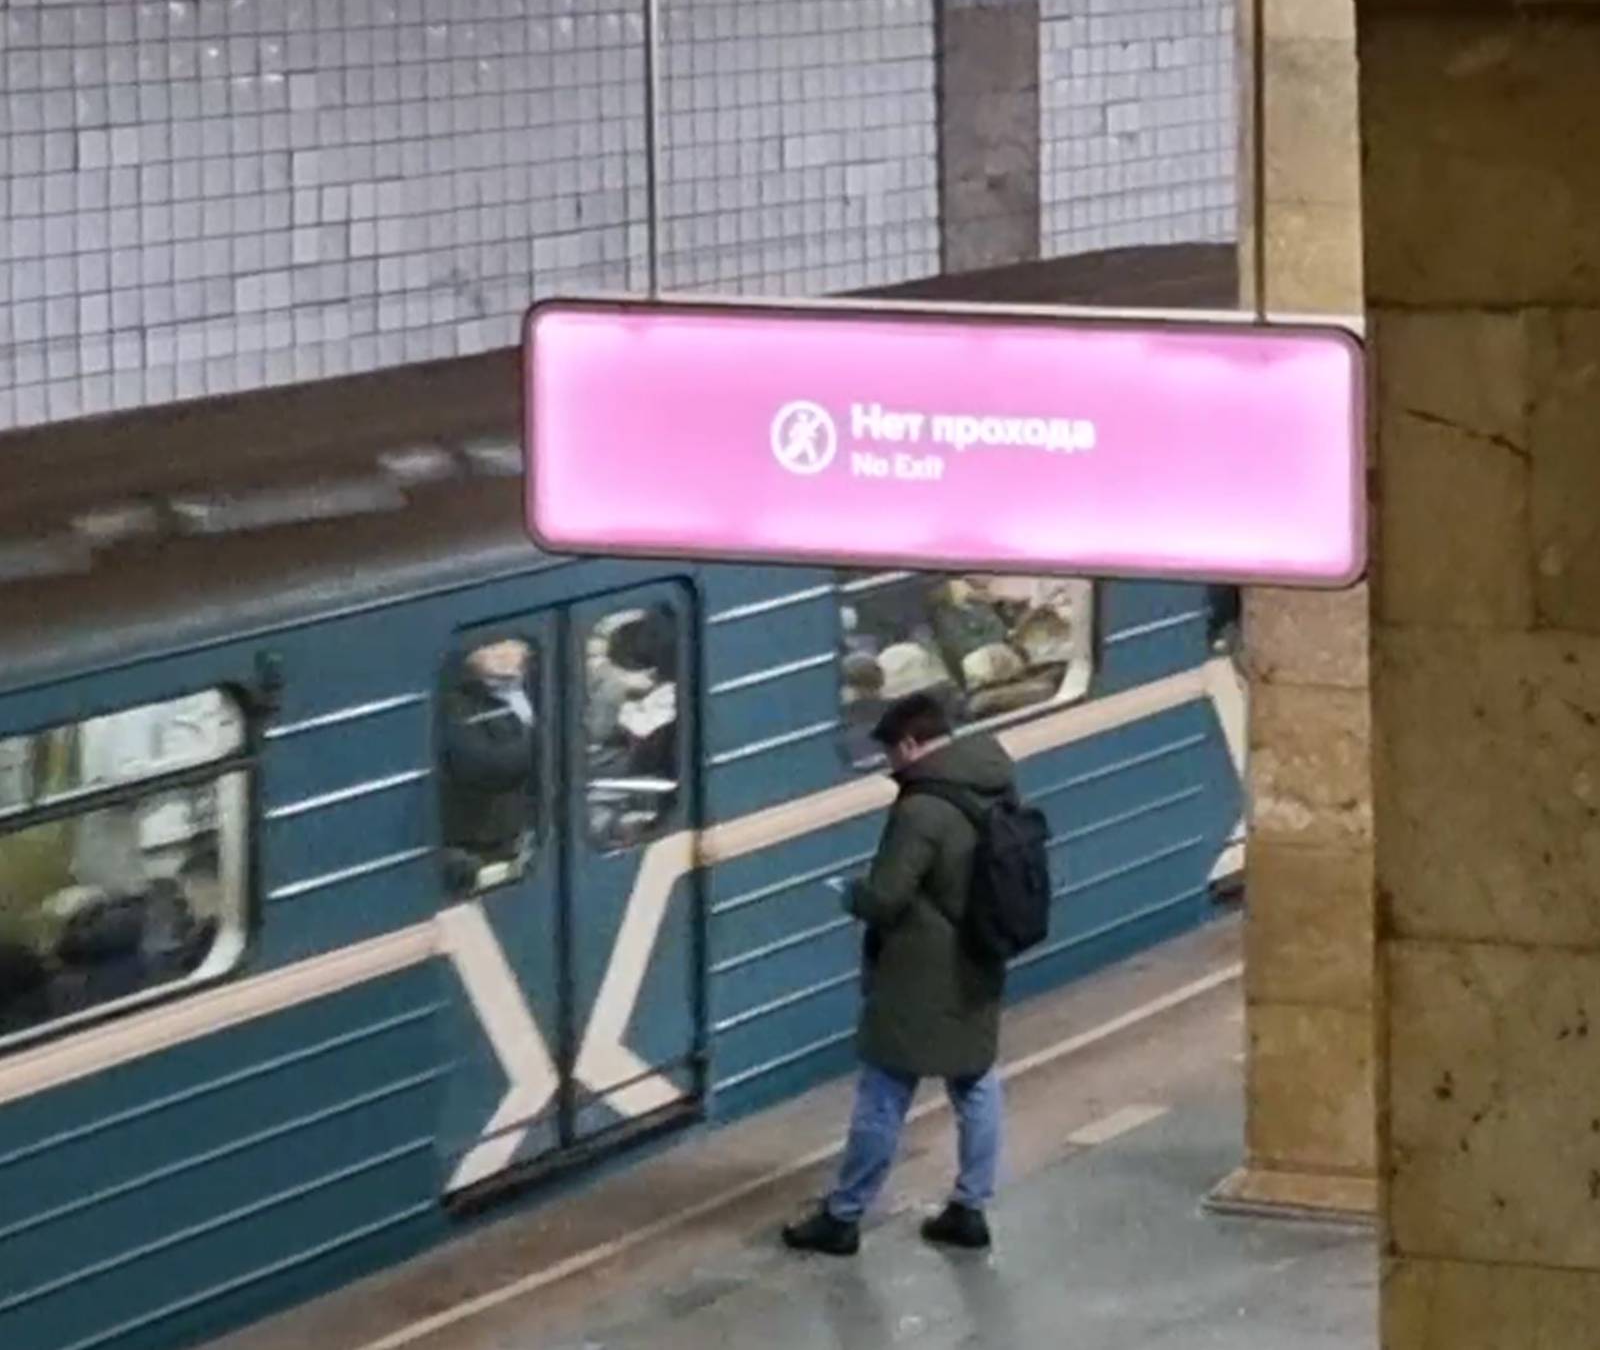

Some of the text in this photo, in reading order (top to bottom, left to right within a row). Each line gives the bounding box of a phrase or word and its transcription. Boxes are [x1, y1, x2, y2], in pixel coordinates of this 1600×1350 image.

[851, 402, 1096, 454] Нет прохода
[851, 453, 945, 480] No Exit
